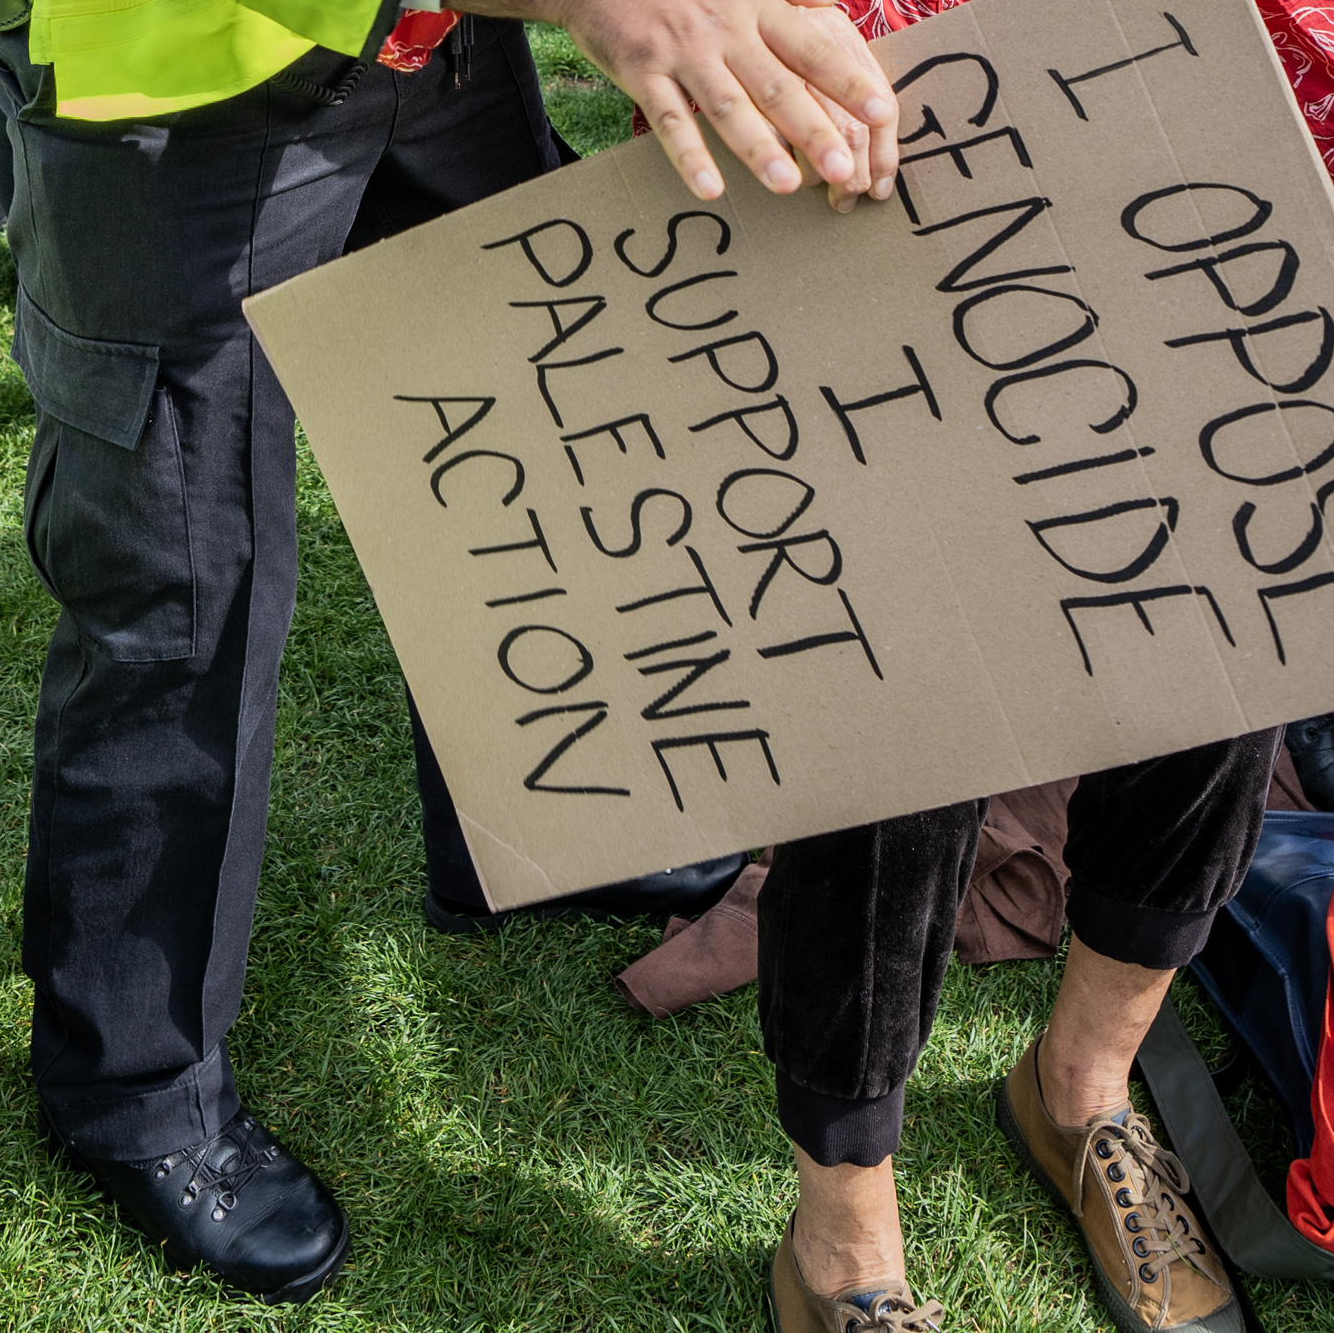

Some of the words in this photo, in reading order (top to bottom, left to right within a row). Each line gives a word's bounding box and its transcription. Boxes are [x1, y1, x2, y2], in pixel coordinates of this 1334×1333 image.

[1047, 12, 1199, 121] I
[481, 219, 780, 812] PALESTINE
[614, 210, 883, 680] SUPPORT
[819, 345, 942, 465] I
[892, 53, 1236, 677] GENOCIDE
[393, 396, 630, 796] ACTION
